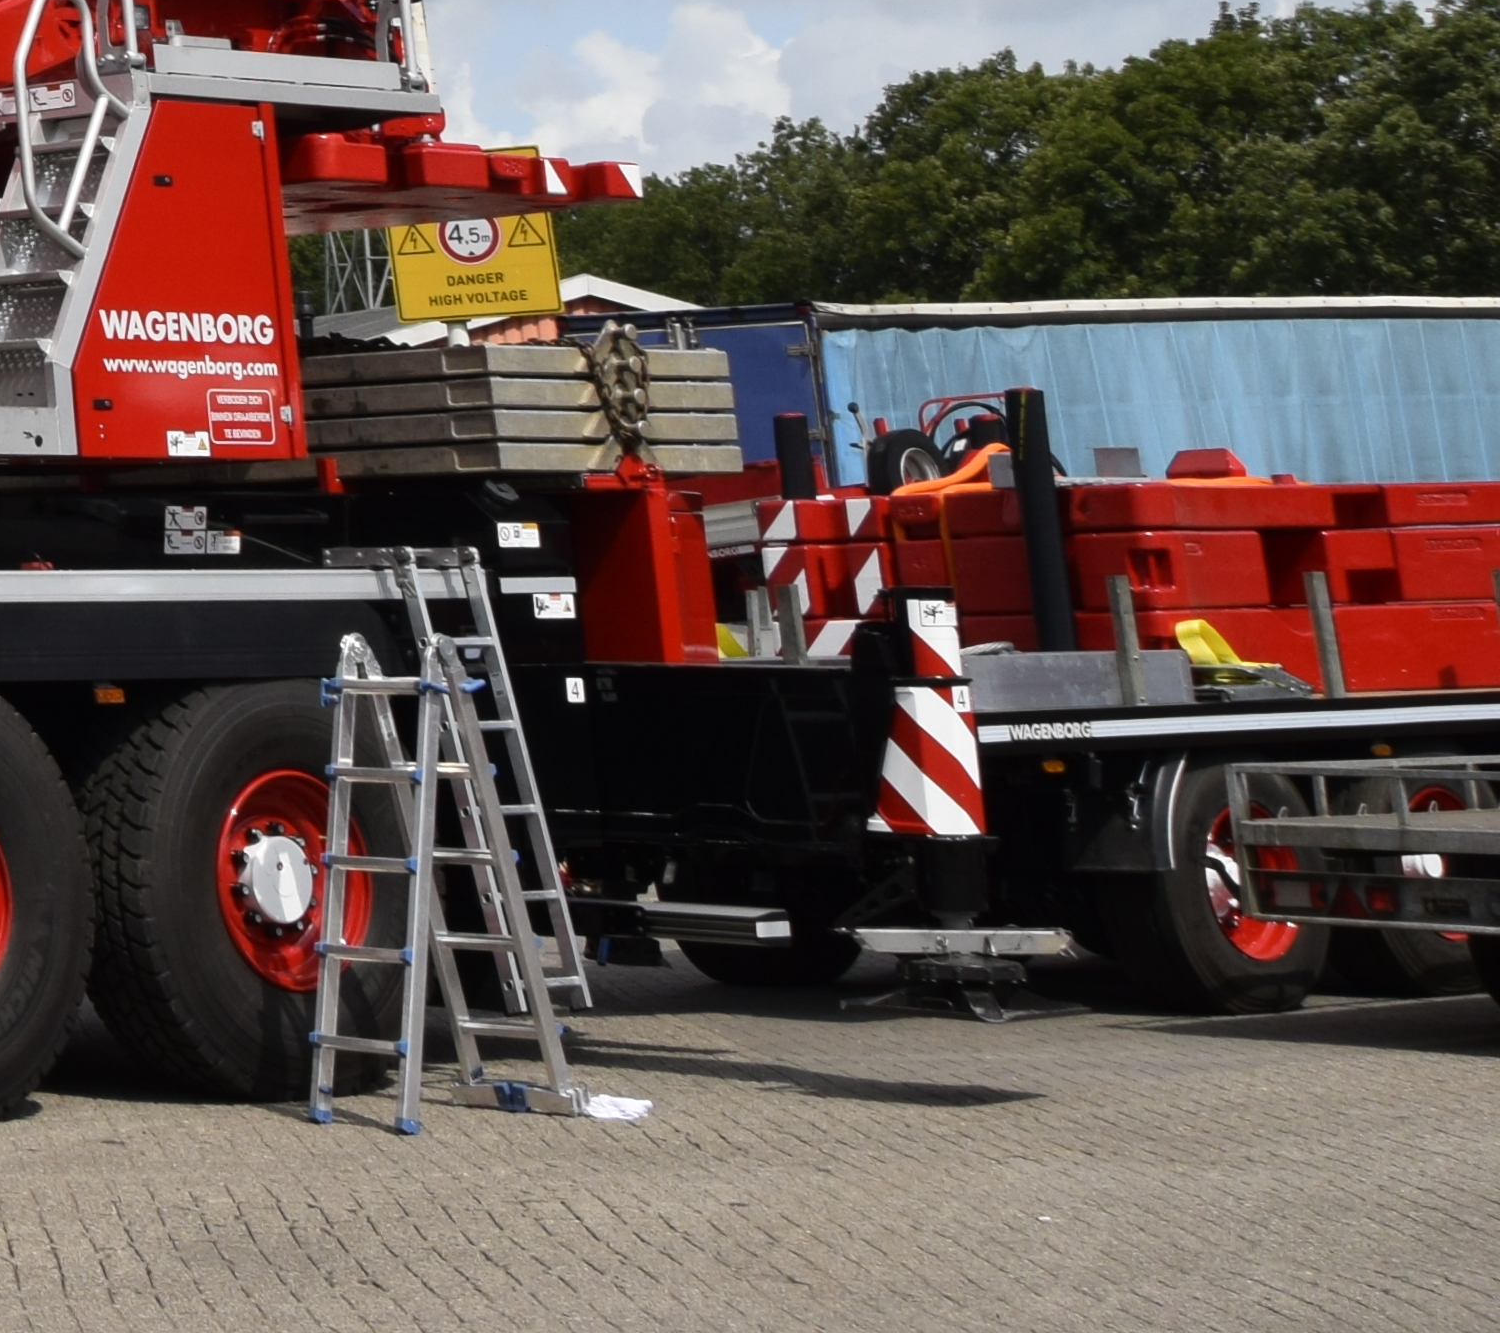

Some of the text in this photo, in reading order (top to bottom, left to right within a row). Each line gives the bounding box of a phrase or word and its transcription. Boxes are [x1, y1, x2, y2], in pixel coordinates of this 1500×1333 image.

[447, 272, 504, 287] DANGER
[429, 290, 528, 306] HIGH VOLTAGE
[99, 309, 274, 345] WAGENBORG
[103, 355, 278, 380] www.wagenborg.com
[570, 681, 581, 699] 4
[957, 690, 966, 708] 4
[1009, 721, 1092, 741] WAGENBORG
